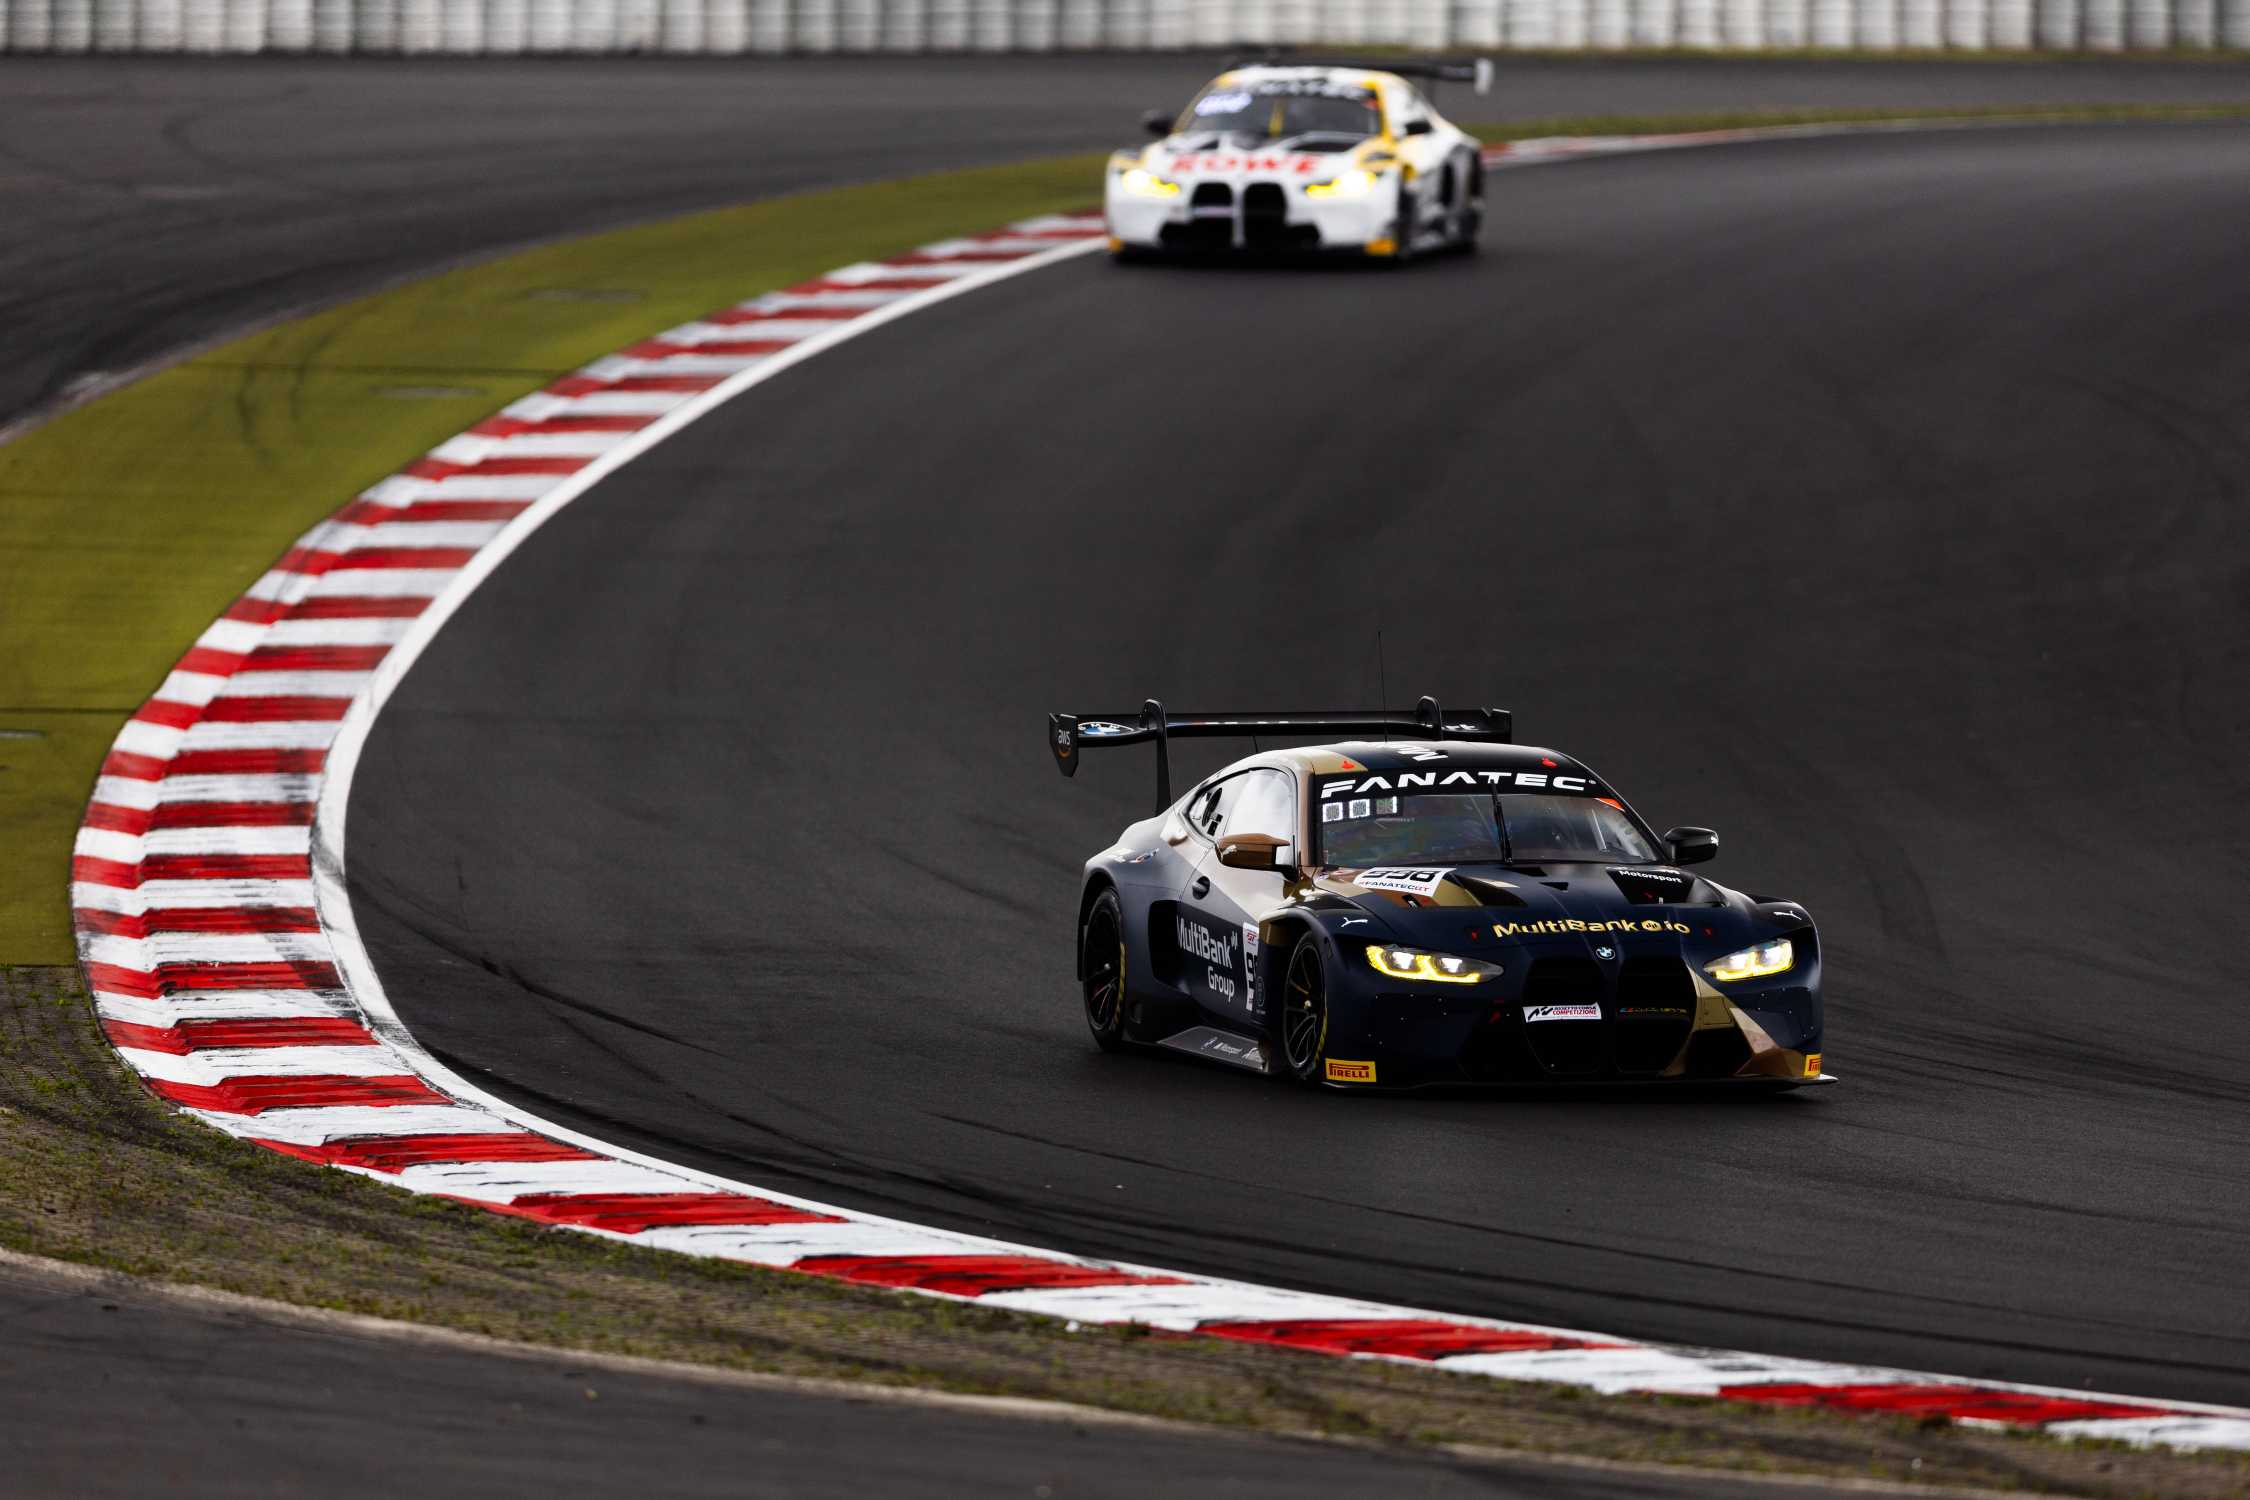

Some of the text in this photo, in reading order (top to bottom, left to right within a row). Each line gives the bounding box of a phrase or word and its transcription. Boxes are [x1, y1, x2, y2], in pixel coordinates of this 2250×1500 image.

[1057, 729, 1071, 745] aws
[1320, 771, 1587, 798] FANATEC
[1619, 870, 1682, 883] Motorsport
[1176, 914, 1233, 969] MultiBank
[1207, 965, 1235, 1003] Group
[1329, 1063, 1370, 1079] PIRELLI
